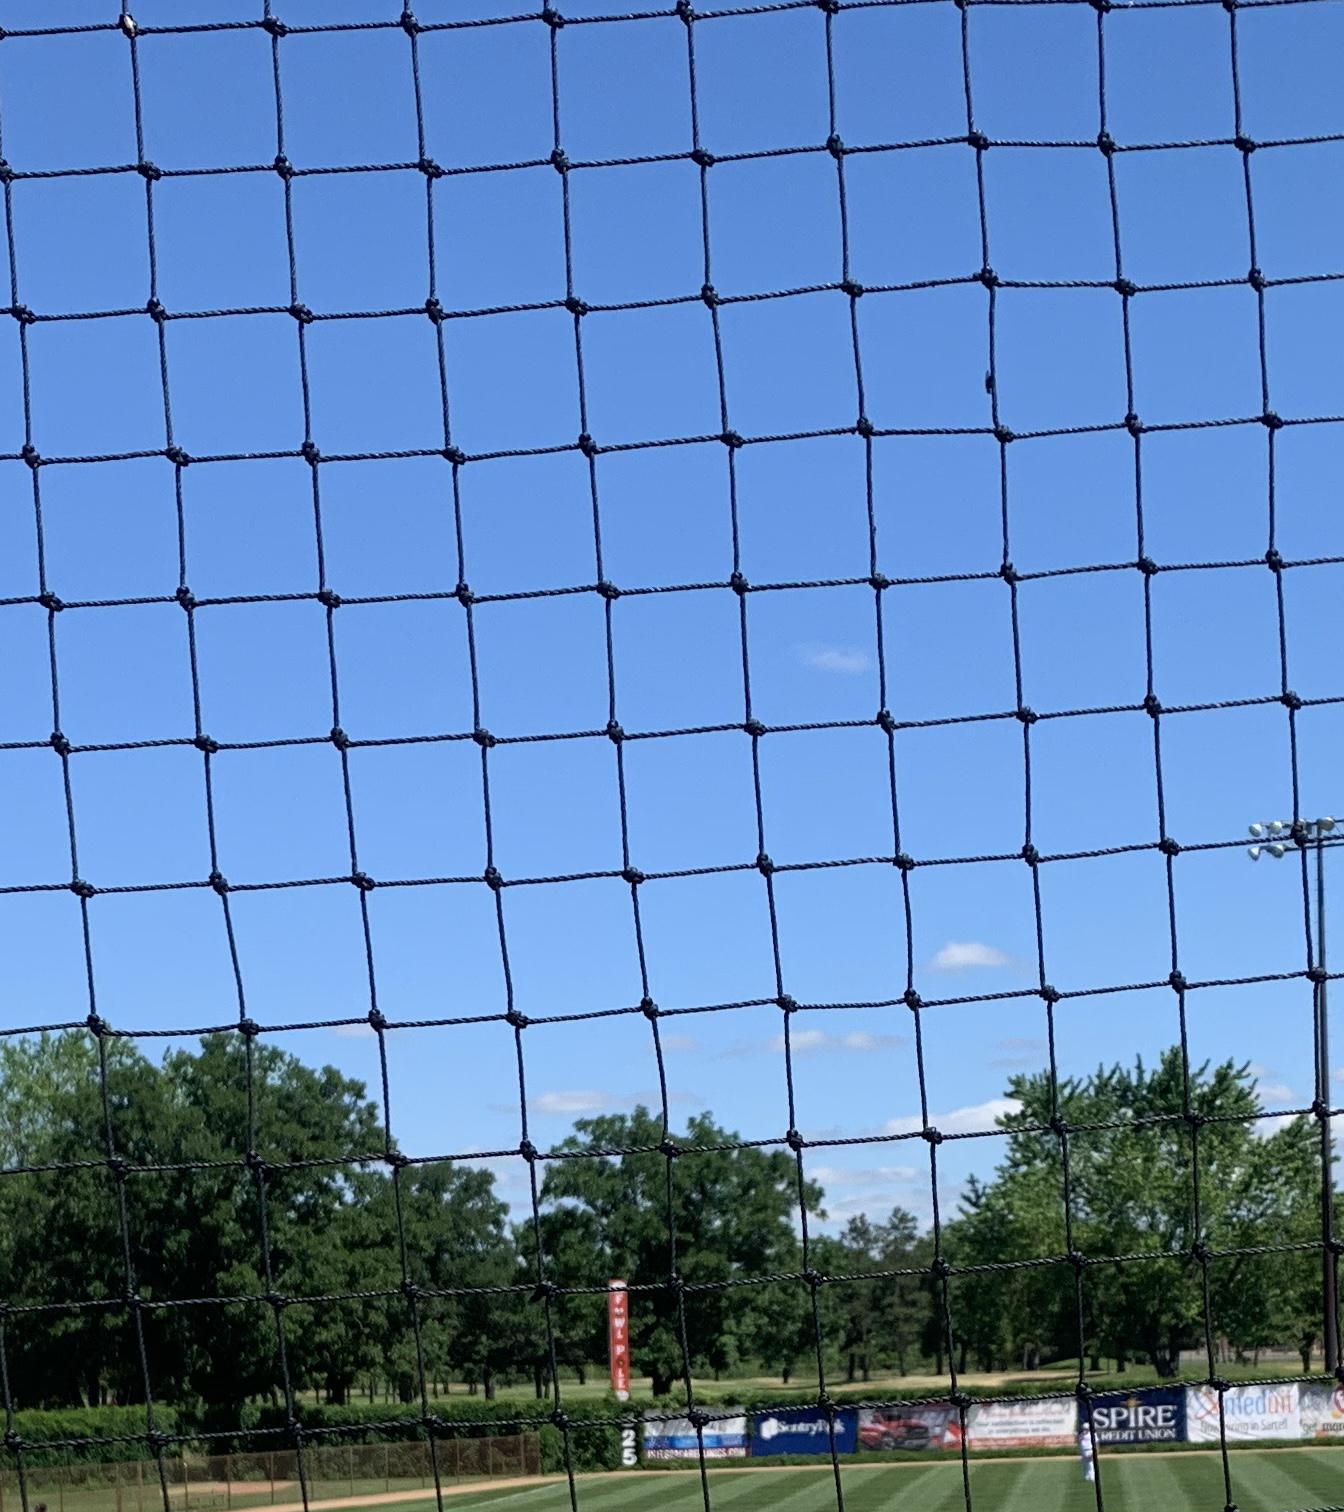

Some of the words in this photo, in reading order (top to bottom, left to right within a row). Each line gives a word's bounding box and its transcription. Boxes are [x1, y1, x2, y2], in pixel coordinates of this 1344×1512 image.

[1093, 1405, 1176, 1429] SPIRE
[1096, 1429, 1136, 1441] REDIT
[1138, 1428, 1176, 1440] UNION
